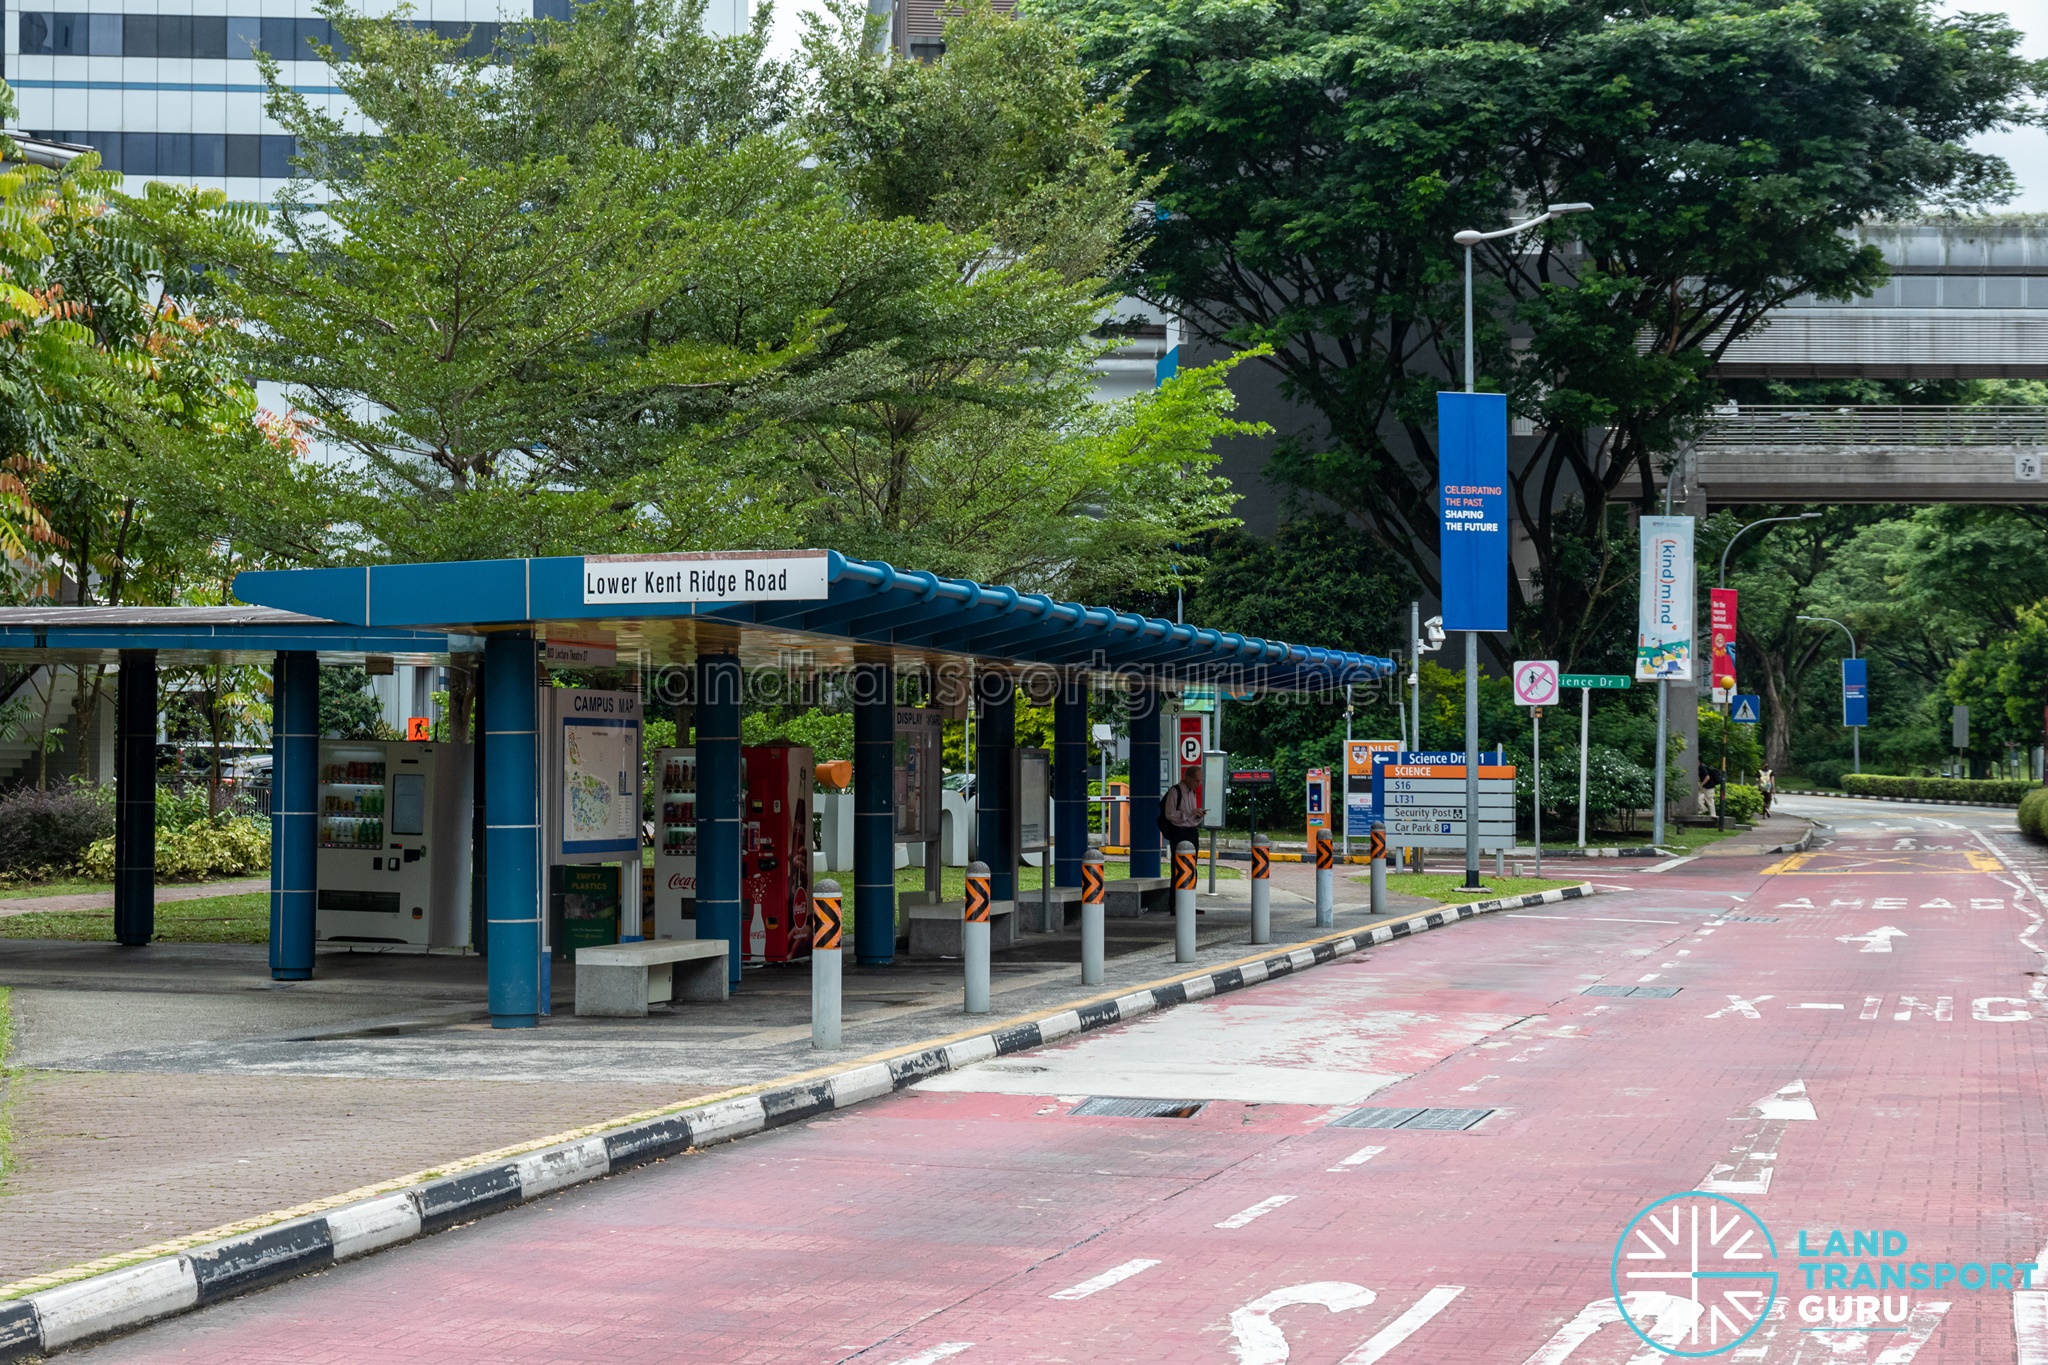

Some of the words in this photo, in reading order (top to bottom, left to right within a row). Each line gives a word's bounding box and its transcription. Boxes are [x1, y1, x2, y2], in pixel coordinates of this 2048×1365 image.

[2021, 462, 2035, 473] 7m
[1445, 485, 1502, 496] CELEBRATING
[1445, 498, 1461, 507] THE
[1445, 510, 1484, 519] SHAPING
[1445, 522, 1462, 531] THE
[1464, 523, 1498, 532] FUTURE
[587, 572, 637, 595] Lower
[645, 571, 682, 593] Kent
[690, 570, 737, 596] Ridge
[745, 569, 787, 592] Road
[1558, 677, 1593, 687] ience
[1600, 677, 1613, 687] Dr
[1620, 679, 1624, 687] 1
[574, 695, 614, 713] CAMPUS
[618, 698, 634, 714] MAP
[896, 712, 922, 725] DISPLAY
[1409, 752, 1447, 765] Science
[1451, 753, 1466, 764] Dri
[1480, 754, 1485, 764] 1
[1394, 766, 1431, 777] SCIENCE
[1395, 780, 1411, 790] S16
[1394, 795, 1414, 804] LT31
[1395, 808, 1429, 819] Security
[1432, 808, 1451, 817] Post
[1395, 823, 1410, 832] Car
[1412, 823, 1431, 832] Park
[1434, 824, 1440, 832] 8
[571, 882, 607, 890] PLASTICS
[1778, 897, 2006, 910] AHEAD
